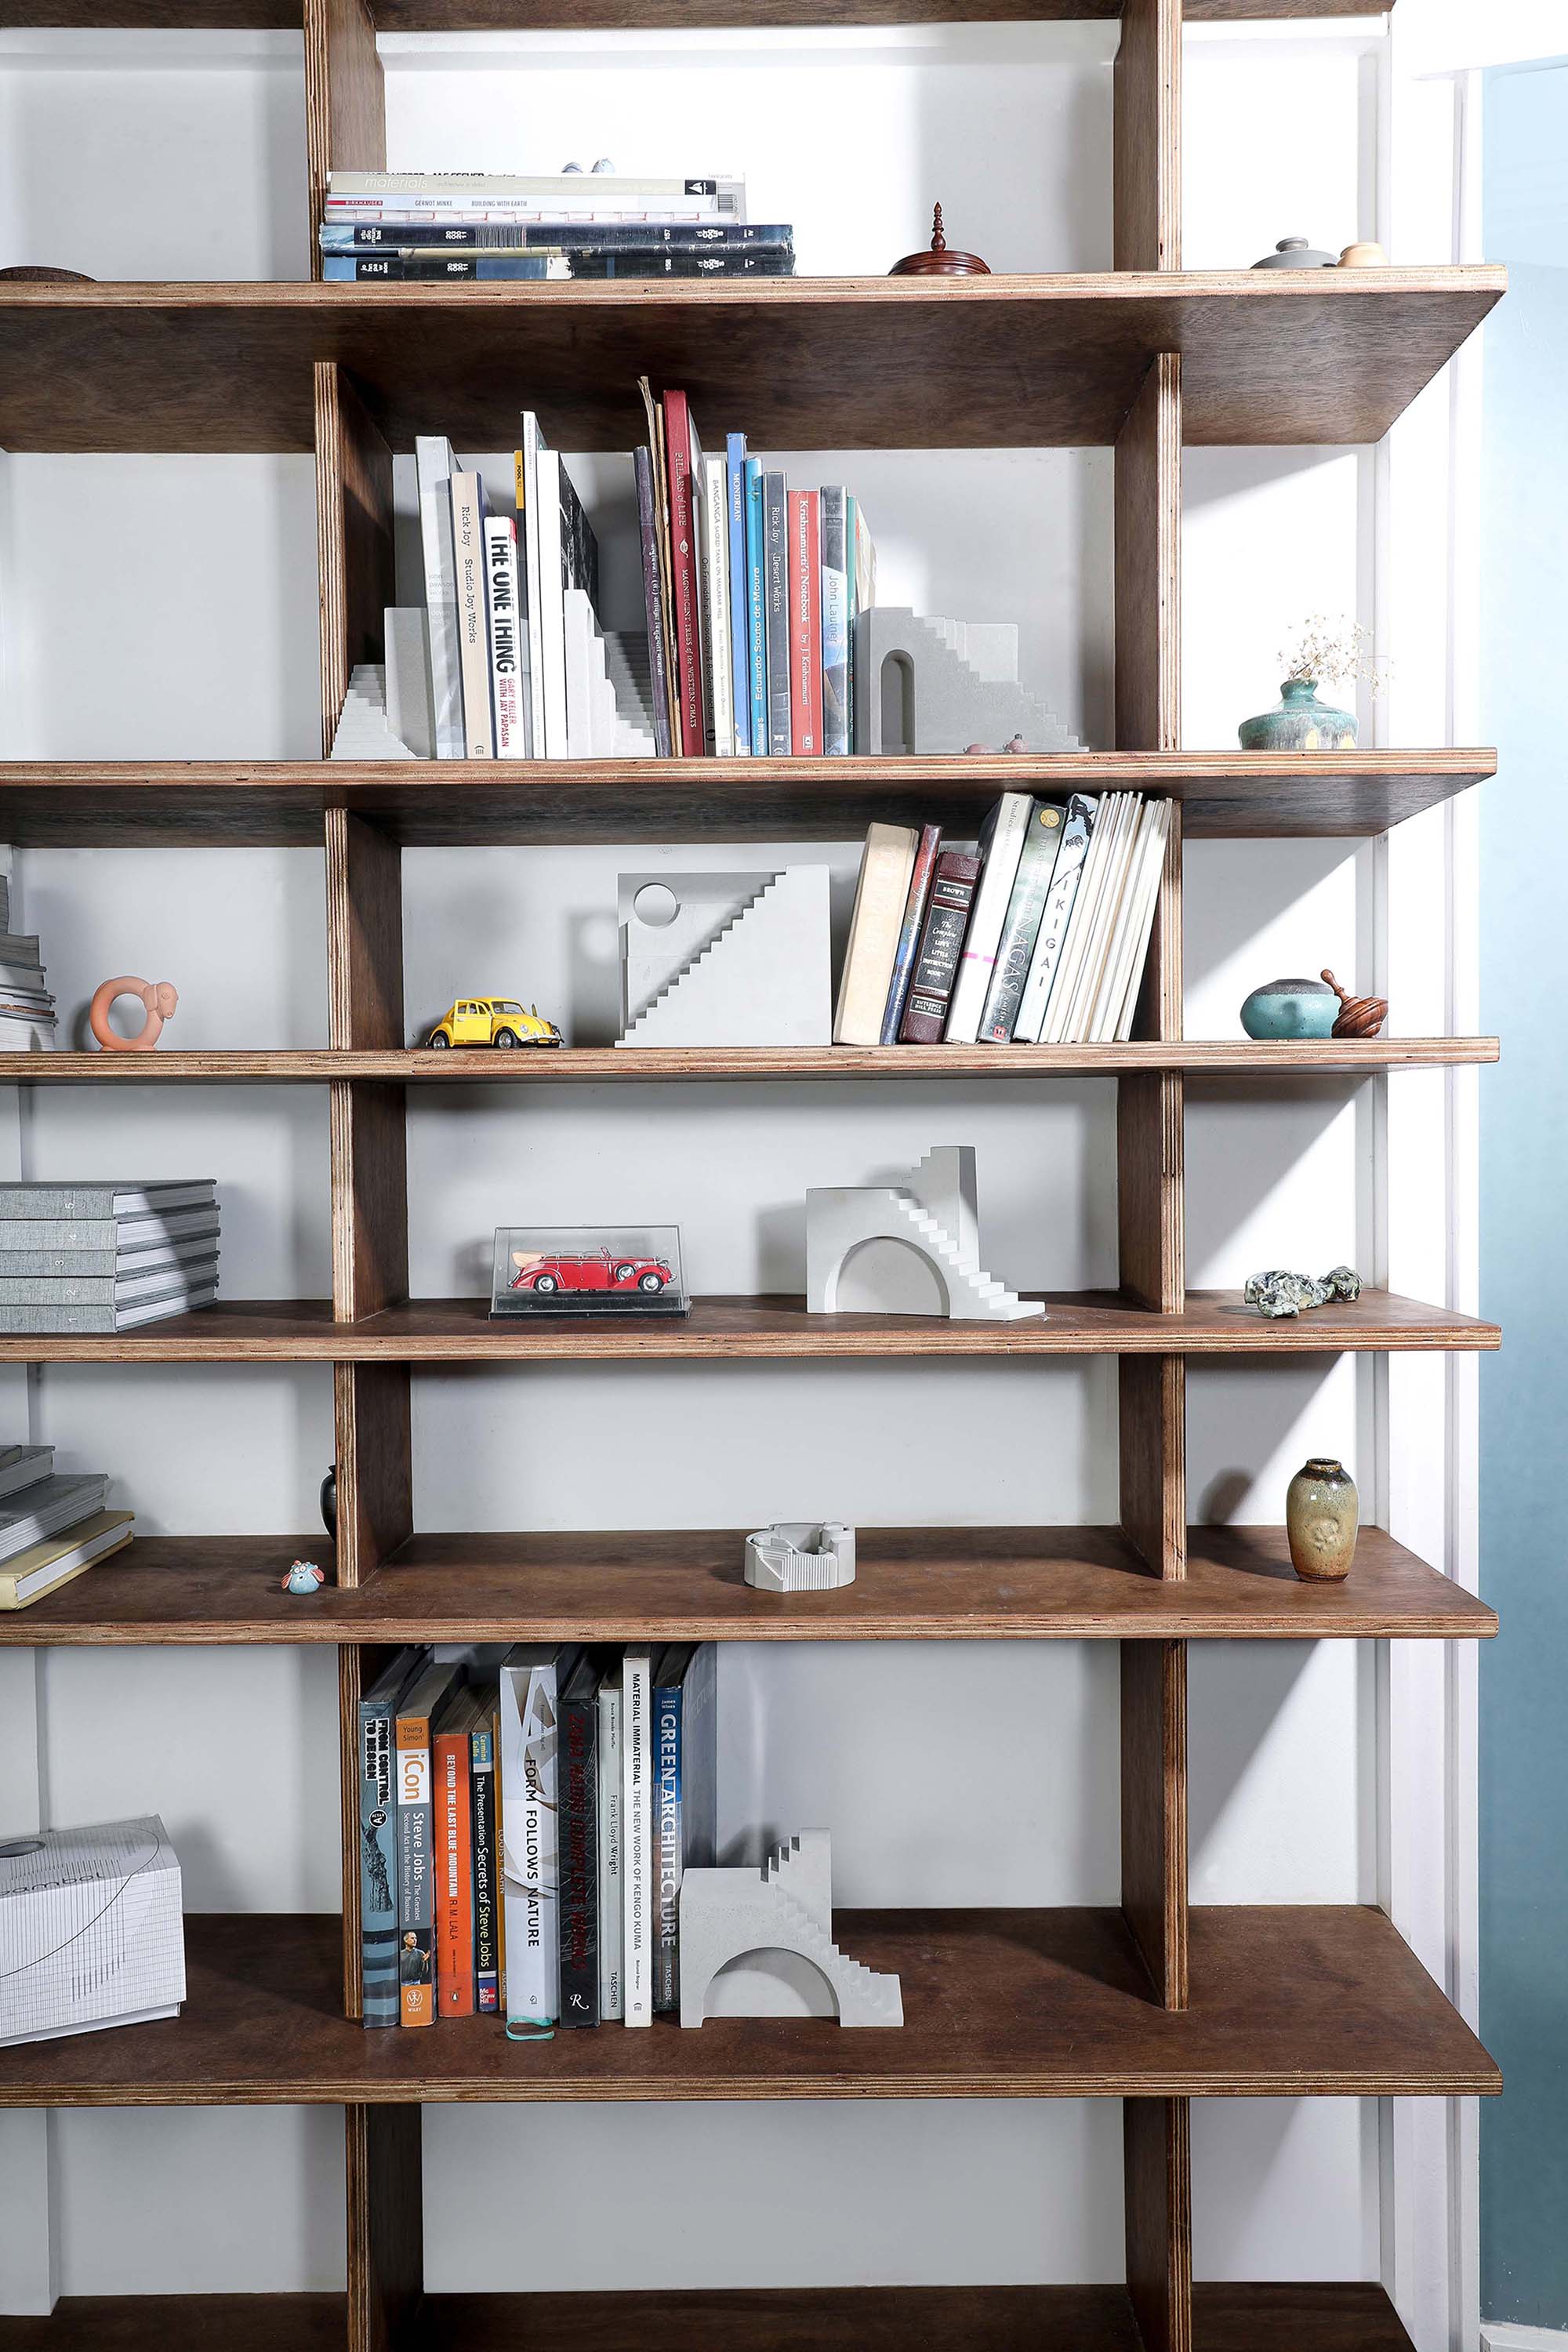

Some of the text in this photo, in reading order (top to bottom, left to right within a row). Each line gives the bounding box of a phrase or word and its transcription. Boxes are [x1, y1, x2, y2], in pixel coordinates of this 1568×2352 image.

[365, 176, 427, 189] materials
[675, 452, 685, 492] PILLARS
[733, 473, 742, 521] MONDRIAN
[461, 506, 471, 547] Rick Joy
[771, 506, 780, 543] Rick Joy
[702, 557, 710, 569] On
[464, 559, 477, 644] Studio Joy Works
[753, 567, 761, 601] Moura
[772, 556, 782, 612] Desert Works
[800, 575, 810, 623] Notebook
[491, 535, 517, 673] THE ONE THING
[753, 604, 761, 618] de
[829, 575, 839, 643] John Lautner
[703, 615, 712, 653] Philosophy
[753, 622, 762, 652] Souto
[800, 633, 809, 644] by
[499, 678, 510, 747] WITH JAY PAPASAN
[507, 677, 517, 724] GARY KELLER
[942, 886, 965, 896] BROWN
[1003, 915, 1035, 992] NAGAS
[998, 995, 1010, 1022] AMISH
[365, 1719, 378, 1780] TO DESIGN
[377, 1718, 390, 1806] FROM CONTROL
[404, 1754, 425, 1800] iCon
[403, 1835, 412, 1845] Act
[413, 1811, 424, 1848] Steve
[446, 1755, 458, 1897] BEYOND THE LAST BLUE MOUNTAIN
[608, 1820, 619, 1843] Lloyd
[661, 1714, 677, 1948] GREEN ARCHITECTURE
[413, 1853, 426, 1881] Jobs
[477, 1776, 492, 1967] The Presentation Secrets of Steve Jobs
[525, 1759, 539, 1947] FORM FOLLOWS NATURE
[608, 1845, 619, 1875] Wright
[403, 1865, 412, 1887] History
[633, 1867, 641, 1882] OF
[404, 1896, 412, 1922] Business
[449, 1899, 458, 1907] R.
[449, 1908, 459, 1918] M.
[449, 1920, 459, 1940] LALA
[633, 1920, 642, 1951] KUMA
[569, 1994, 590, 2010] R
